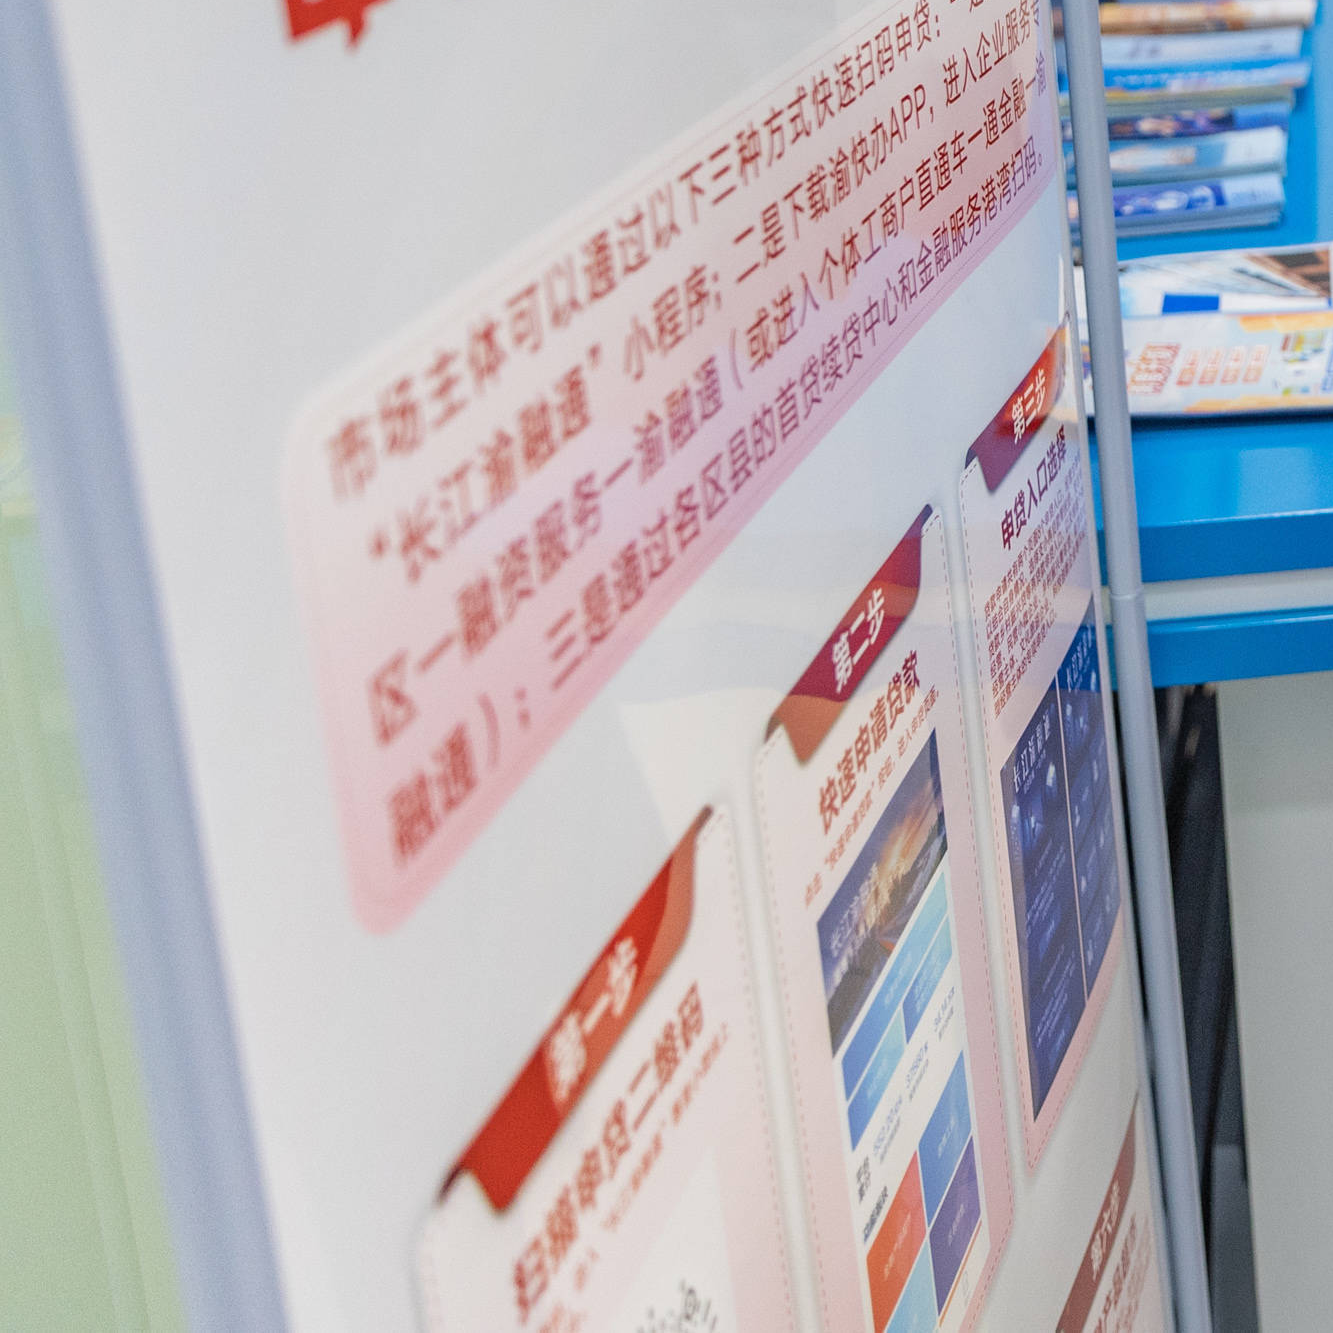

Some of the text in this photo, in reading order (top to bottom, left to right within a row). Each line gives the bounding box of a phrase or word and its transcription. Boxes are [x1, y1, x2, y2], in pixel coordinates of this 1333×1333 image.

[1011, 367, 1046, 445] 第三步
[1001, 424, 1067, 551] 申贷入口选择
[832, 588, 885, 695] 第二步
[818, 649, 921, 836] 快速申请贷款
